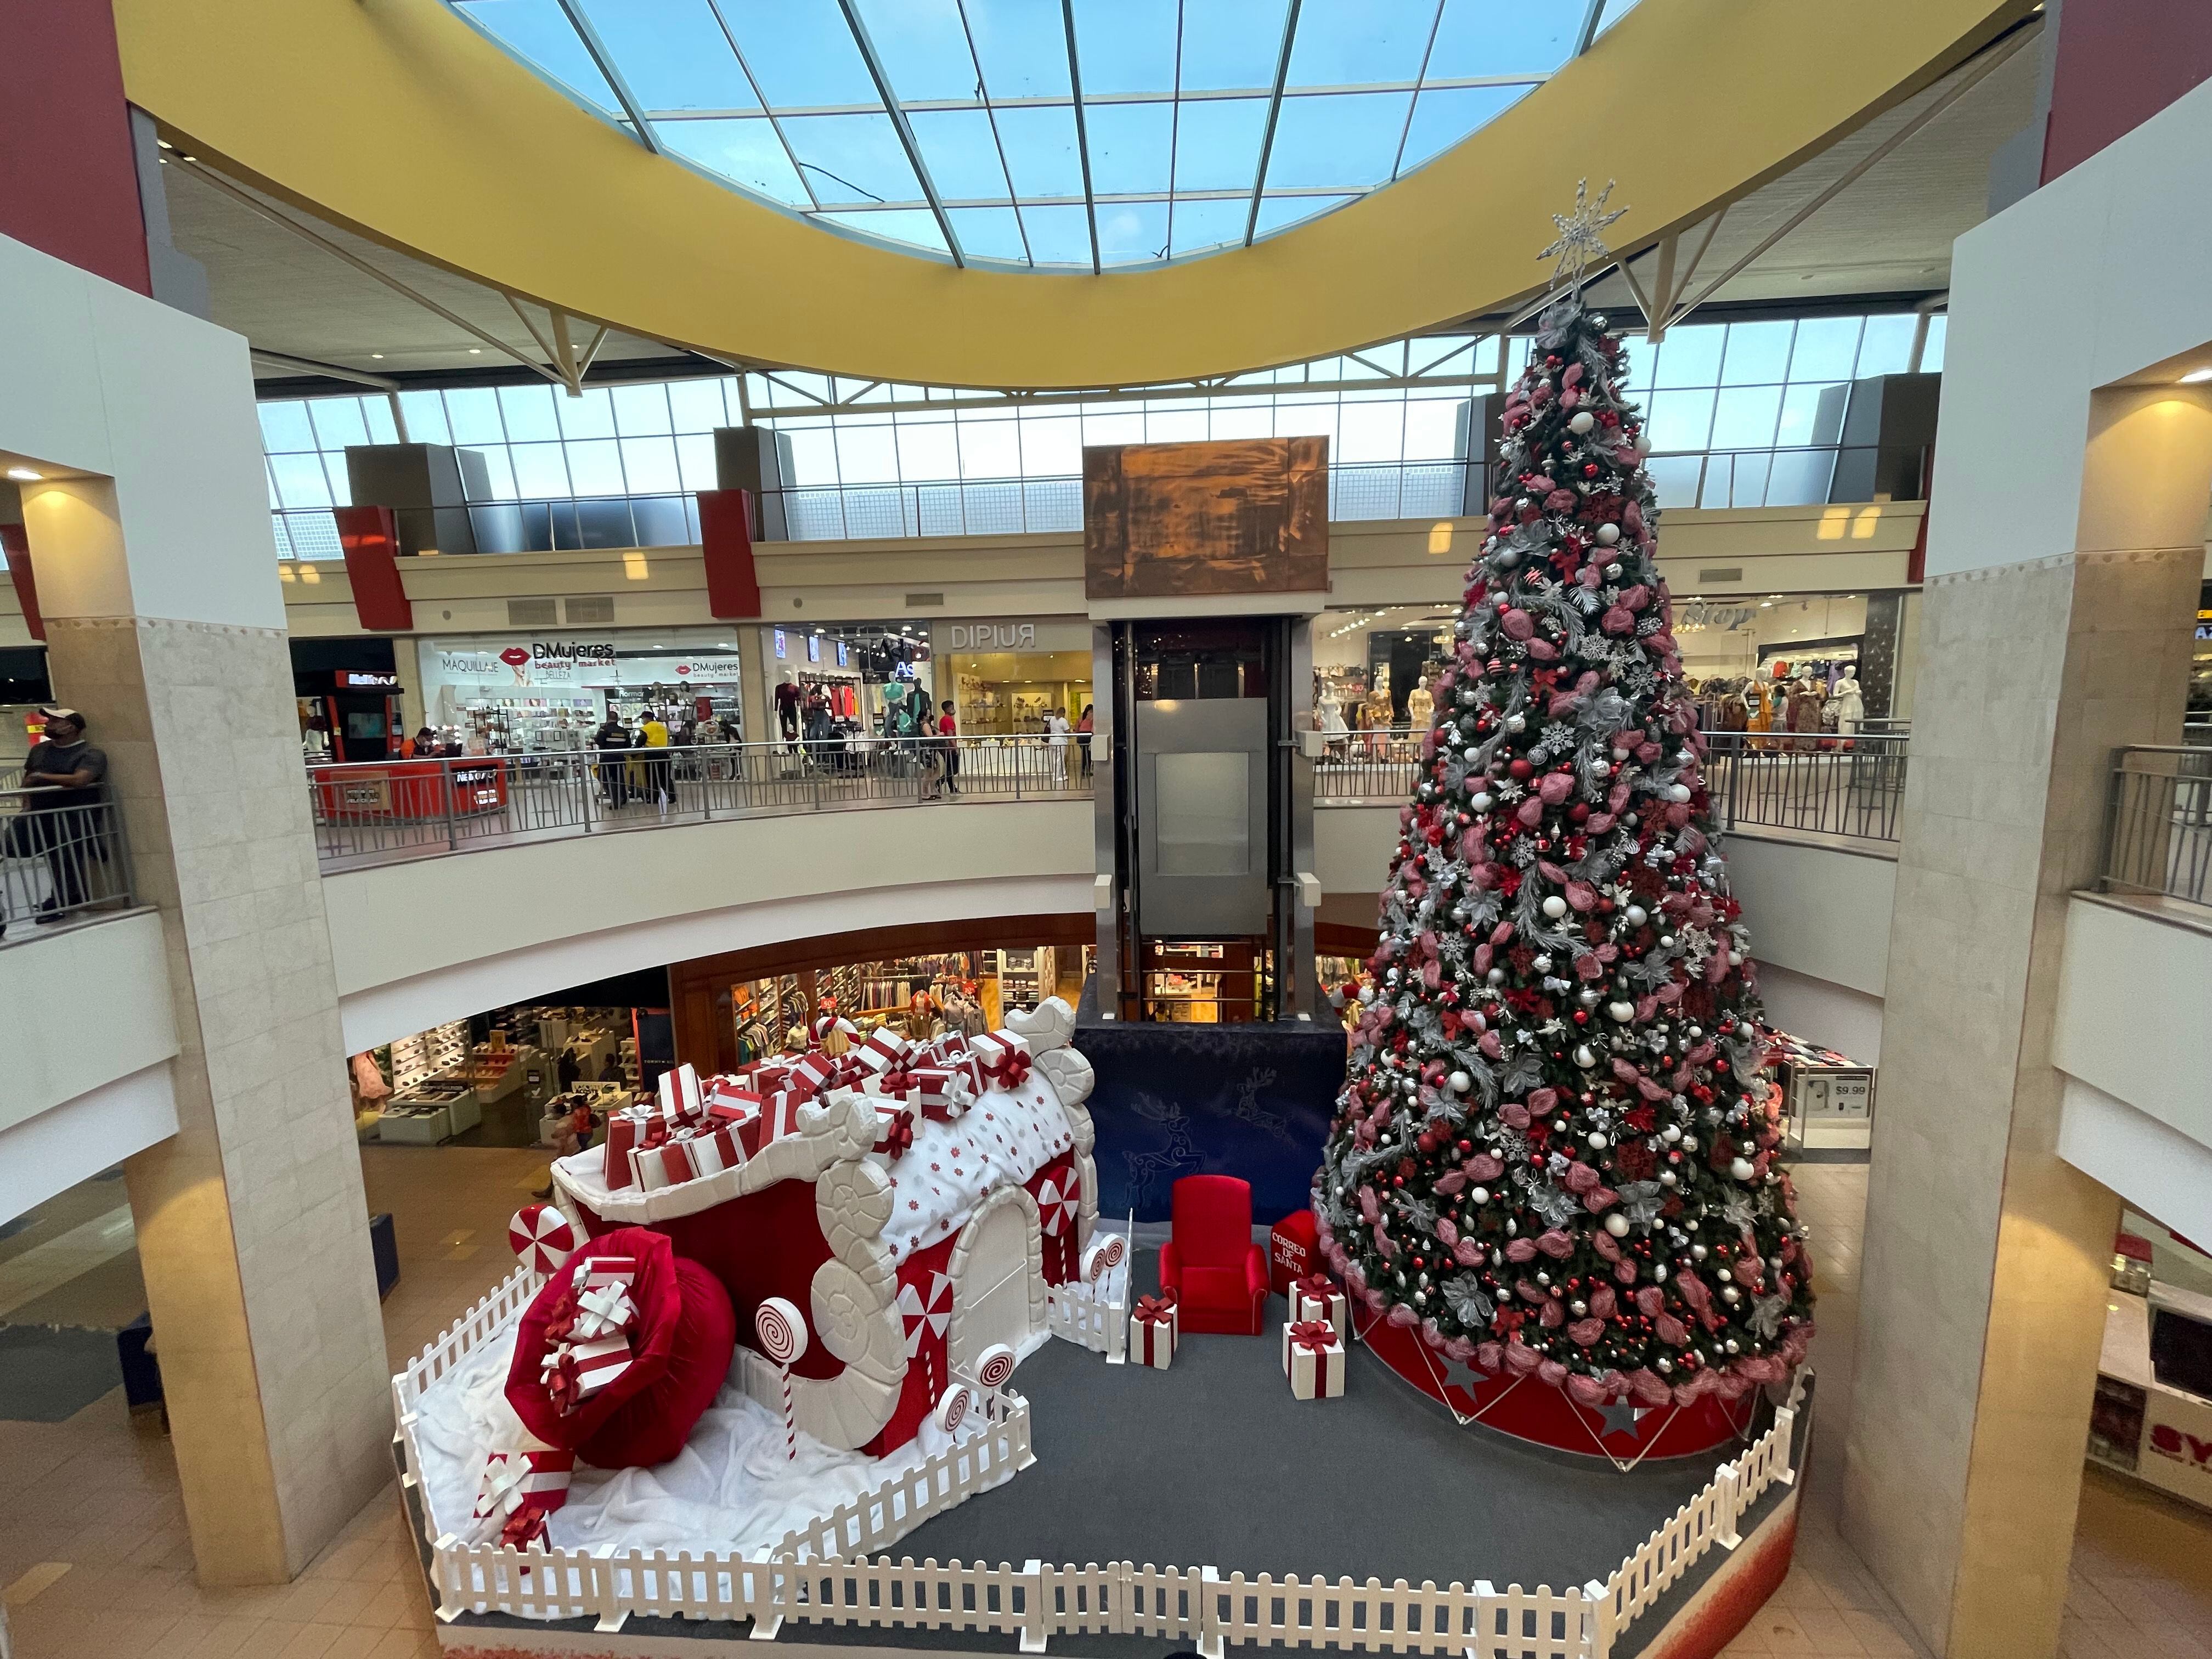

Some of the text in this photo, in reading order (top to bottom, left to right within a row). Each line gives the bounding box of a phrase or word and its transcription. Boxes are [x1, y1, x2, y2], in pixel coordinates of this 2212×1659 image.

[532, 641, 614, 663] DMujeres
[442, 659, 499, 673] MAQUILLAJE
[534, 658, 616, 670] beauty market
[692, 662, 738, 674] DMujeres
[1836, 1086, 1865, 1095] $9.99
[1272, 1232, 1306, 1257] CORREO
[1283, 1247, 1295, 1260] DE
[1274, 1252, 1304, 1276] SANTA
